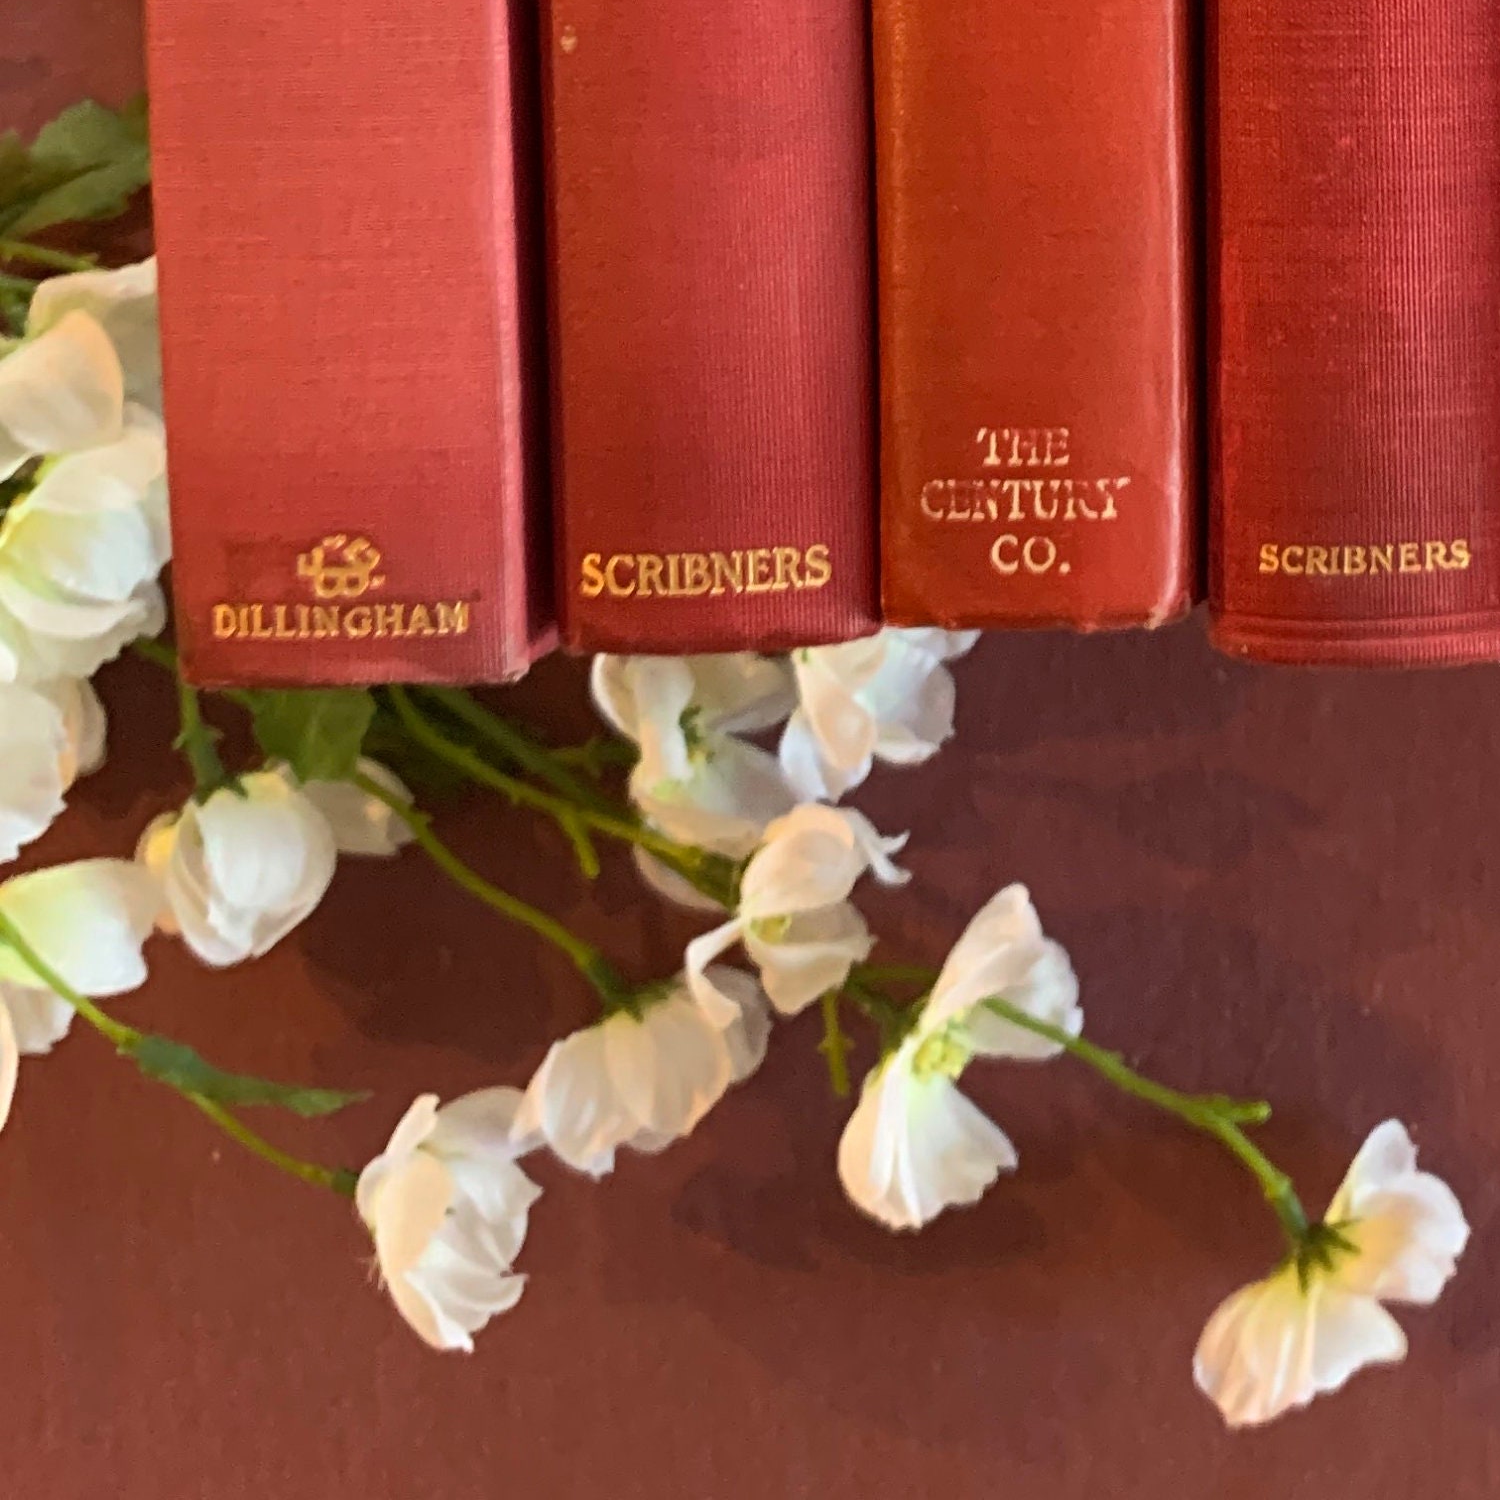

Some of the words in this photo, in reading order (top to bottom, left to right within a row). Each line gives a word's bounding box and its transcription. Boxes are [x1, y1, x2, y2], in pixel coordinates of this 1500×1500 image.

[976, 427, 1070, 467] THE
[920, 476, 1131, 522] CENTURY
[580, 544, 832, 597] SCRIBNERS
[991, 533, 1071, 576] CO.
[1259, 538, 1471, 575] SCRIBNERS
[213, 600, 469, 638] DILLINGHAM
